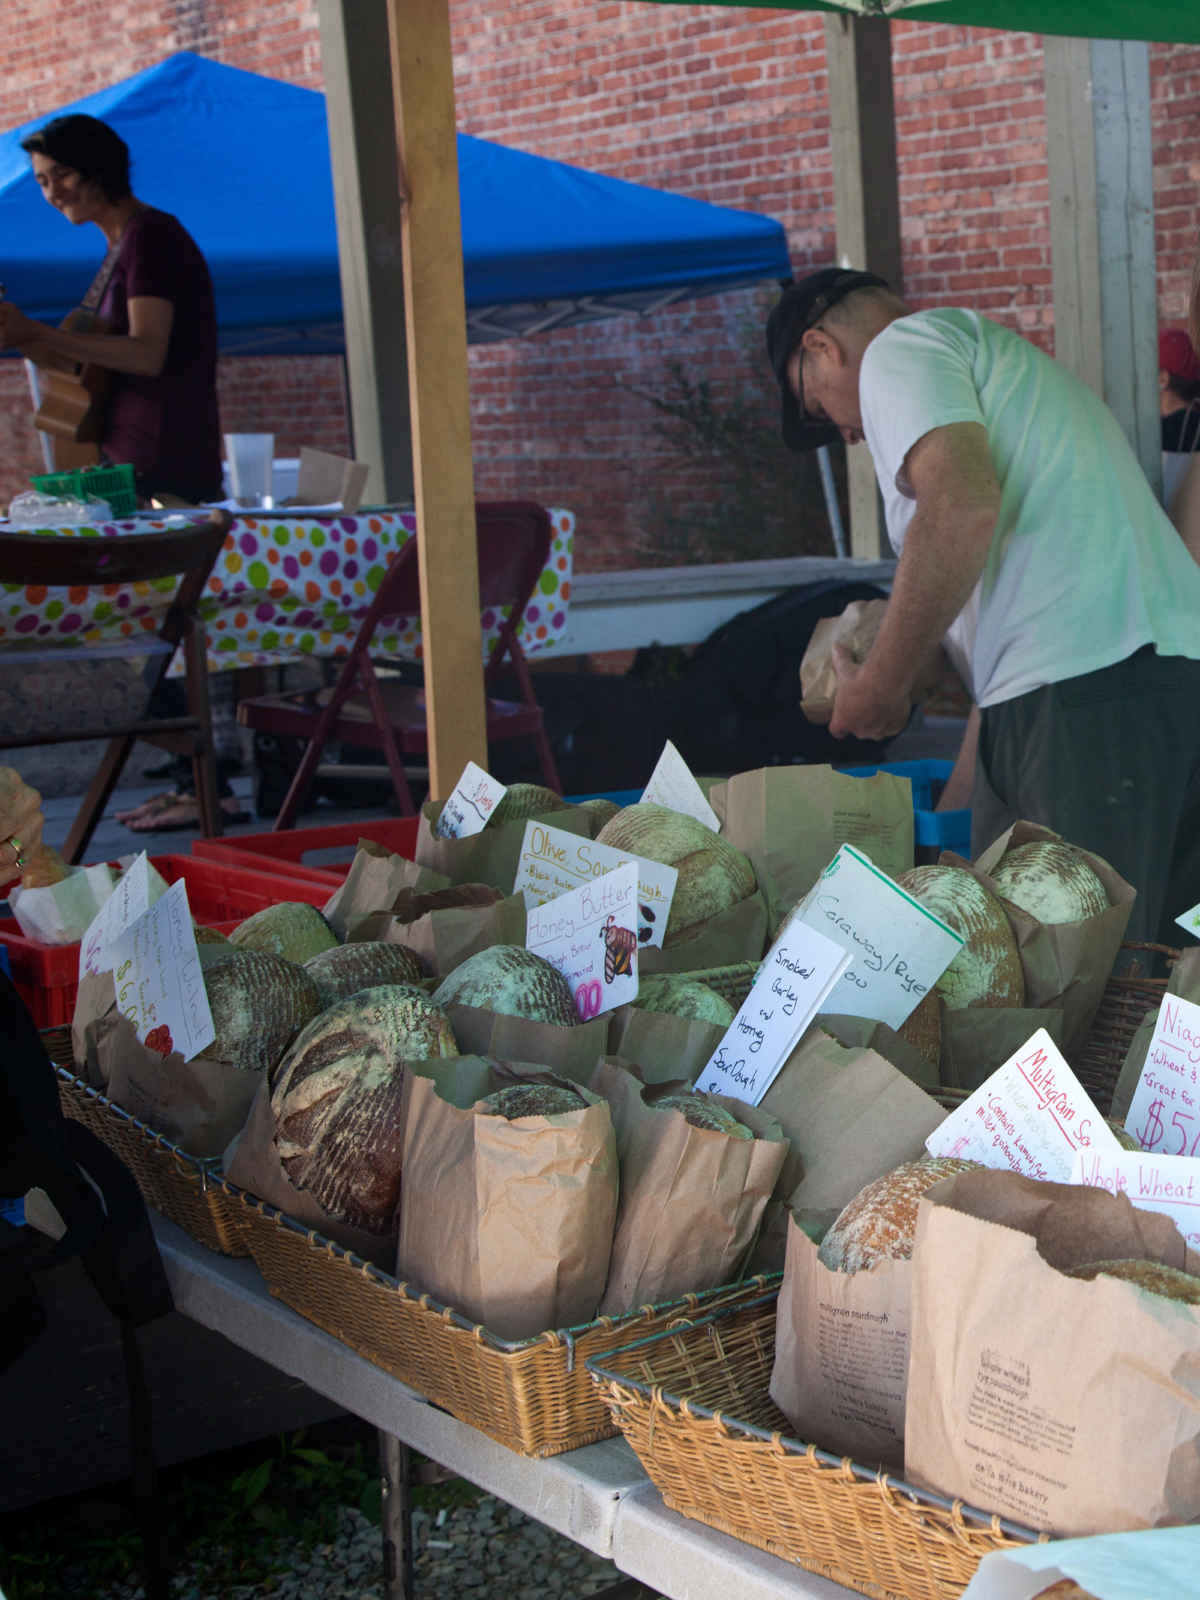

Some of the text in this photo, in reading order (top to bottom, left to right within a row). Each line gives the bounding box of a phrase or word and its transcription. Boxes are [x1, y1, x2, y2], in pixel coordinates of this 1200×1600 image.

[531, 827, 567, 862] Olive
[528, 911, 577, 939] Honey
[580, 885, 632, 921] Butter
[775, 948, 816, 979] Smoked
[817, 895, 927, 997] Caraway/Rye
[737, 1015, 766, 1053] Honey
[1022, 1048, 1076, 1120] Multigrain
[1181, 1090, 1195, 1107] for
[1138, 1165, 1195, 1199] Wheat
